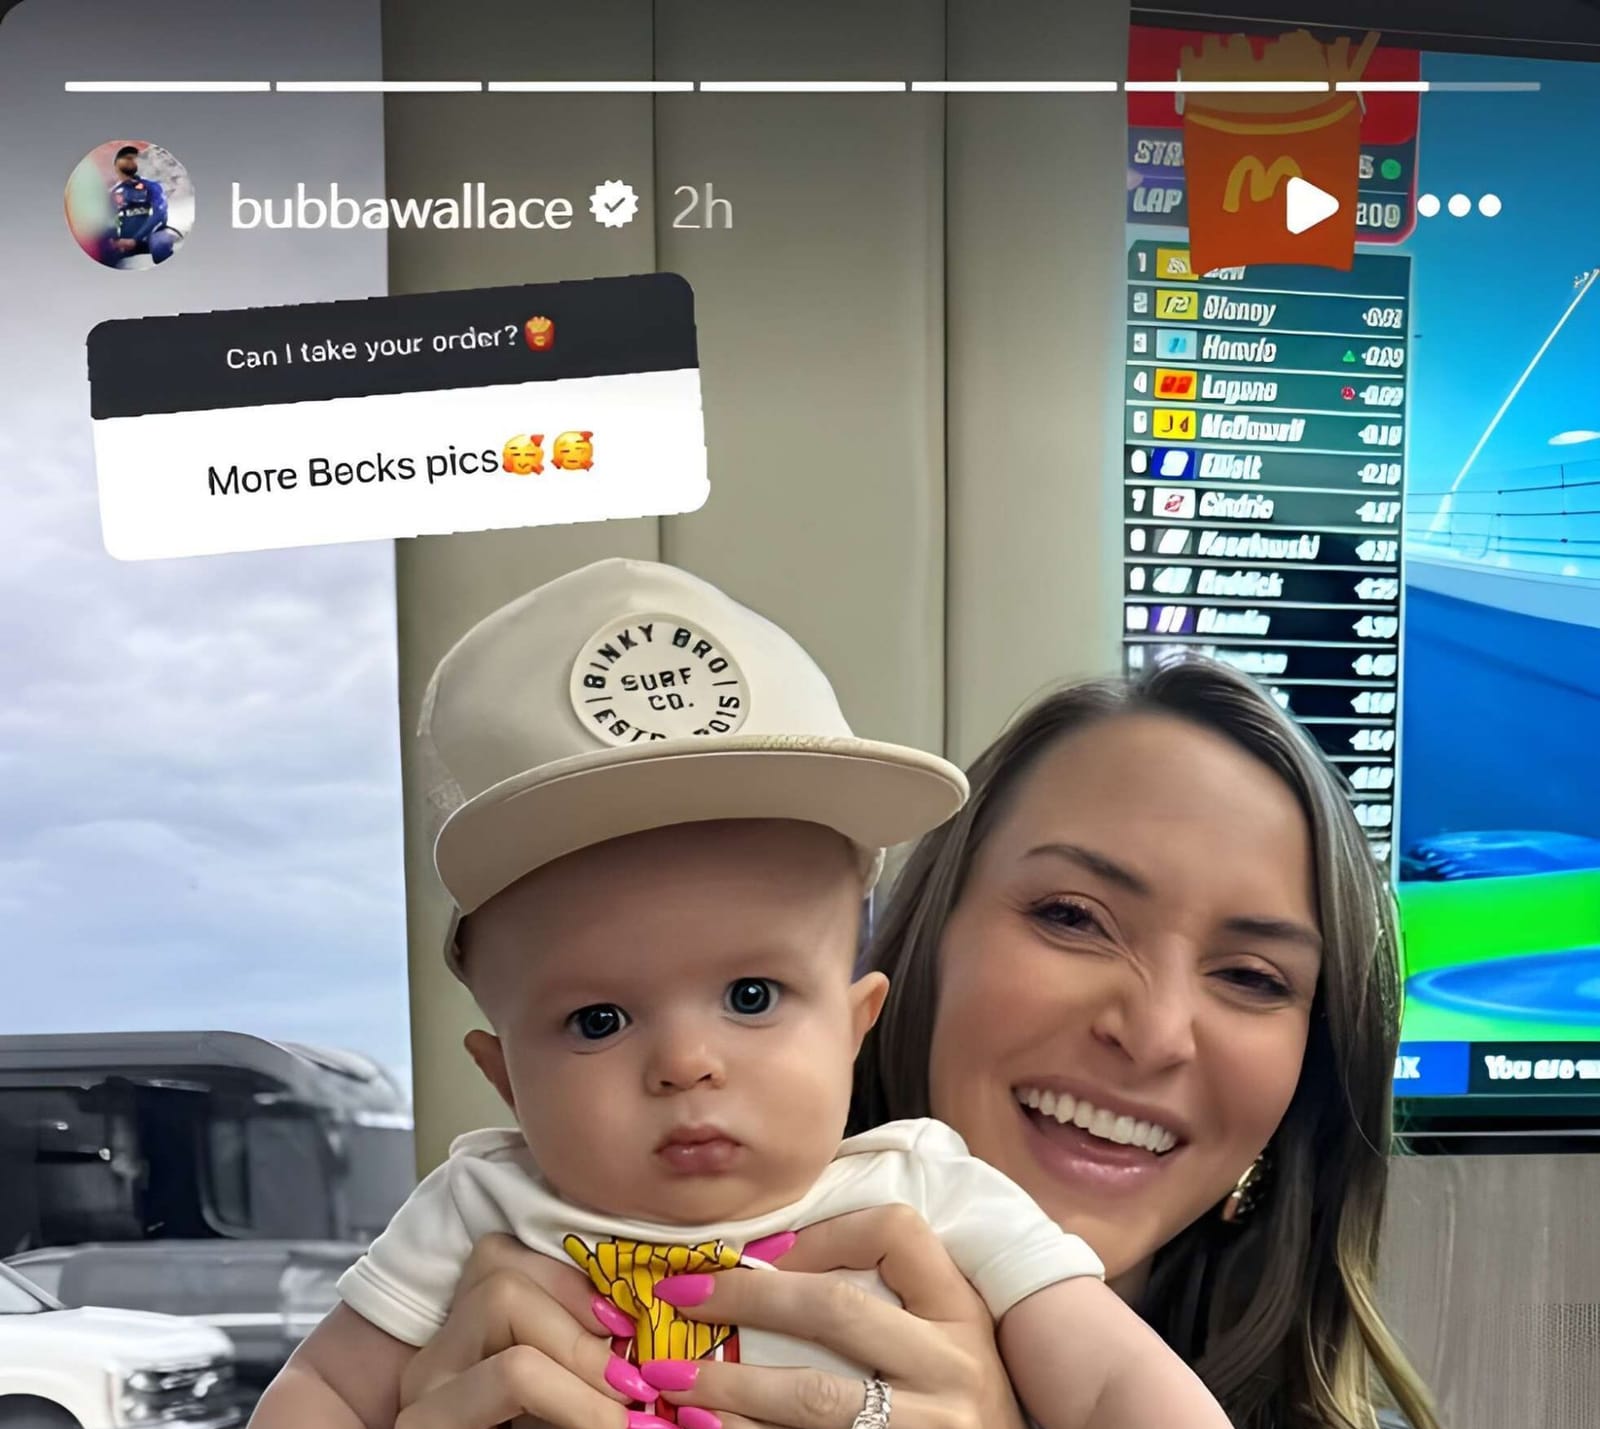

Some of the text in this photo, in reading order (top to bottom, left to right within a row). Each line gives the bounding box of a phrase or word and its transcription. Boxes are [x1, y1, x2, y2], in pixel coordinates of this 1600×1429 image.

[1134, 140, 1184, 167] STA
[1133, 187, 1182, 213] LAP
[583, 623, 729, 689] BINKY BRO
[620, 667, 691, 691] SURF
[648, 693, 695, 711] CO.
[1485, 1055, 1532, 1080] You
